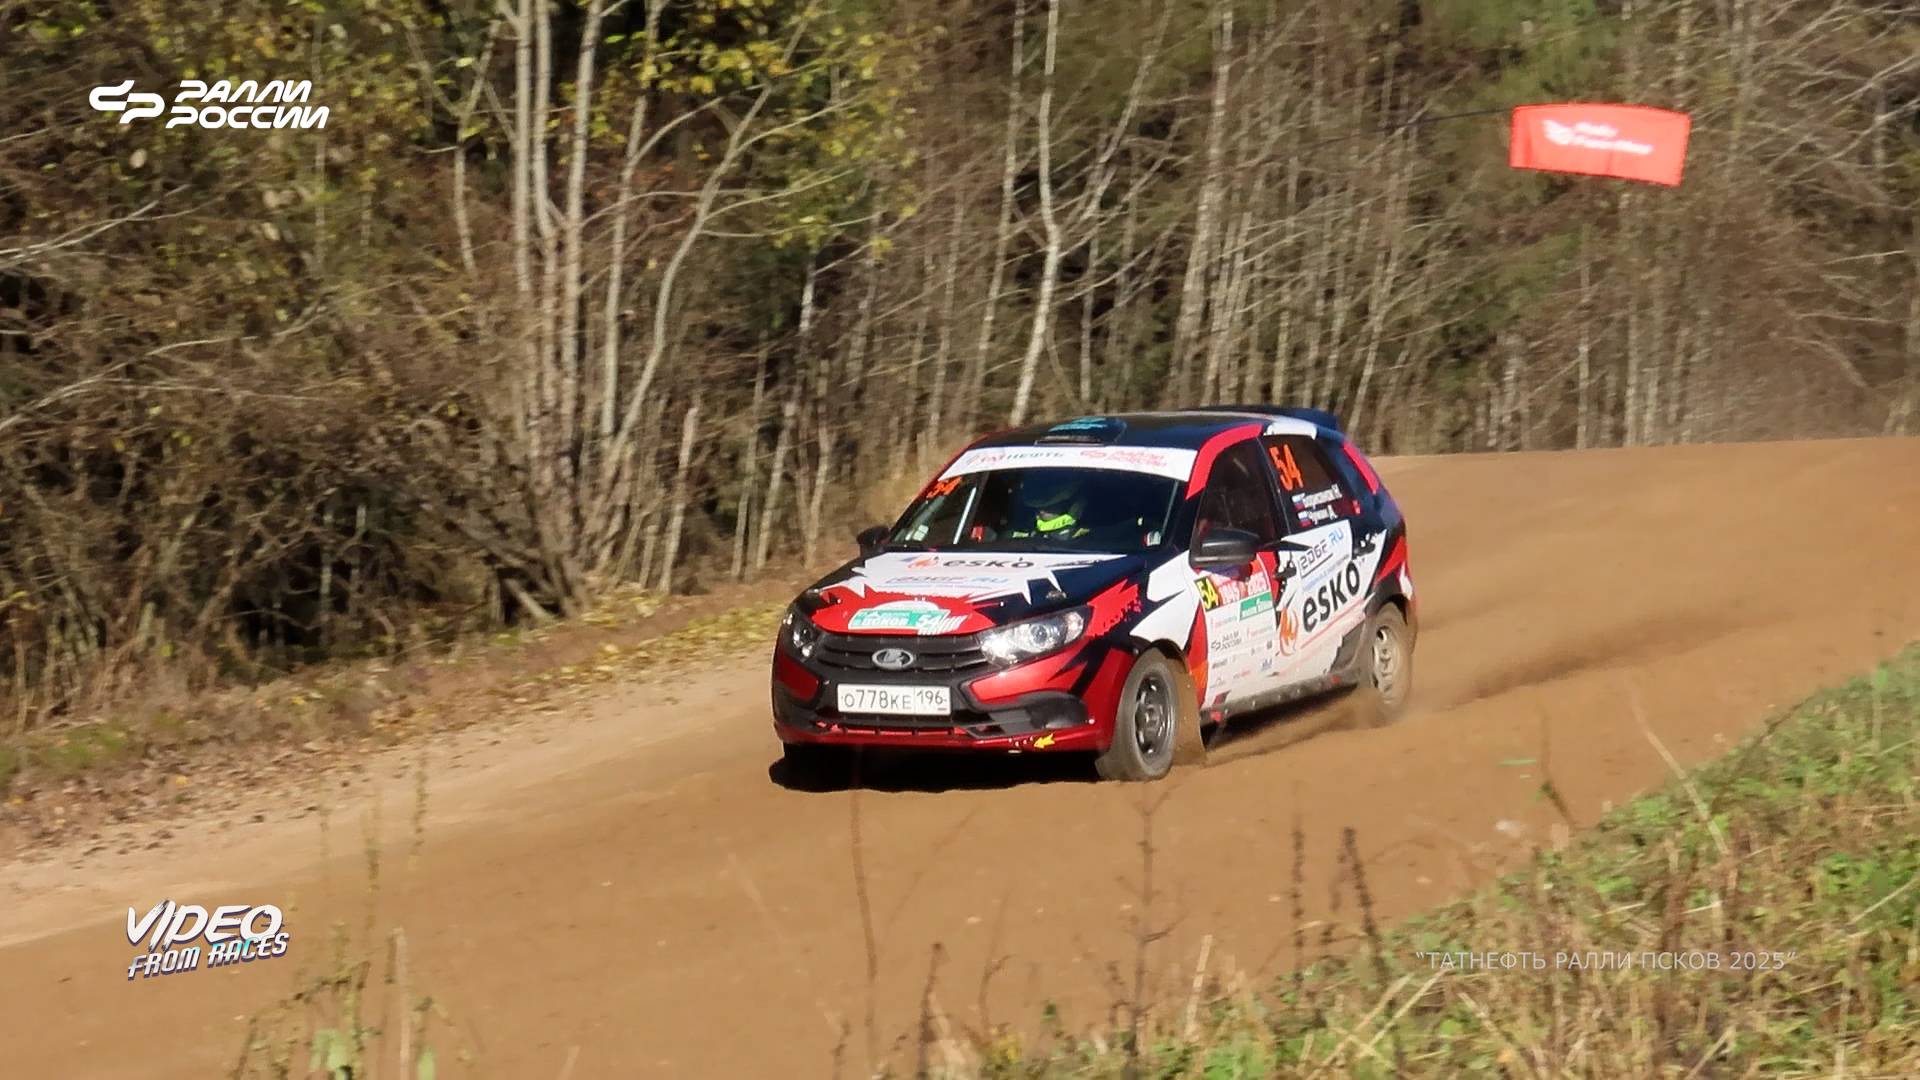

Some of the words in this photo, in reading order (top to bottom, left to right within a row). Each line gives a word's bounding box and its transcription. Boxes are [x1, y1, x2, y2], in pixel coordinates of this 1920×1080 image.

[1268, 443, 1305, 492] 54
[926, 476, 962, 499] 54
[943, 558, 1035, 569] esko
[1196, 578, 1219, 611] 54
[1302, 561, 1360, 633] esko
[915, 614, 941, 628] 54
[843, 688, 912, 710] О778КЕ
[916, 690, 943, 705] 196
